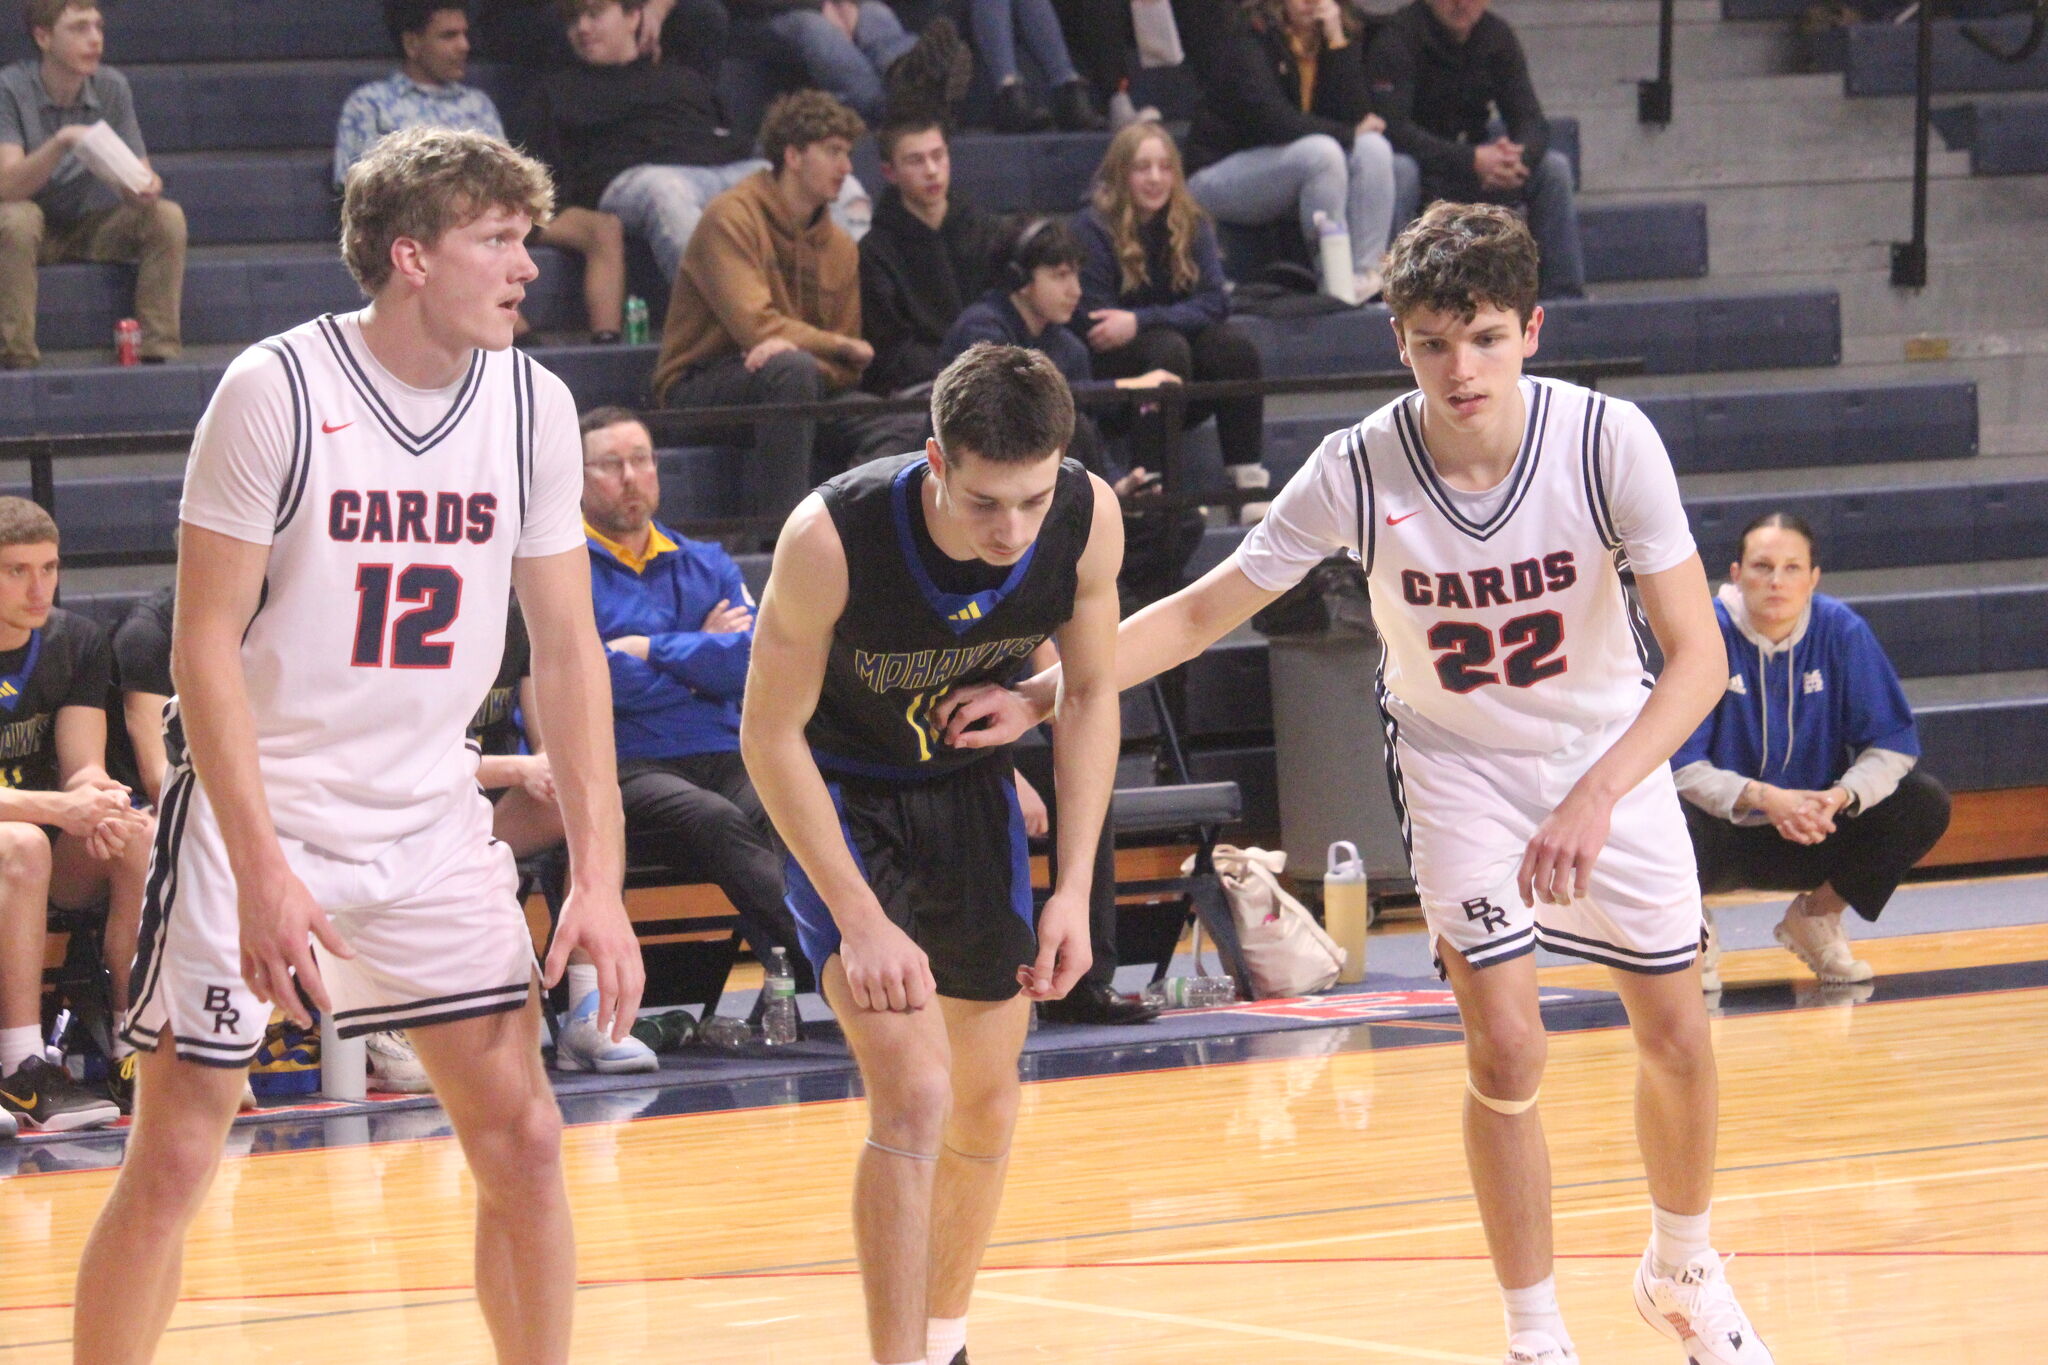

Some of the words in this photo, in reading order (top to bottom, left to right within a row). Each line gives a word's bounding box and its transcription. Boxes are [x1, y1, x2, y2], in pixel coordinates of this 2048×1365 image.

[328, 489, 498, 545] CARDS
[1400, 550, 1577, 609] CARDS
[350, 563, 464, 670] 12
[855, 634, 1045, 694] MOHAWKS
[1427, 609, 1568, 694] 22
